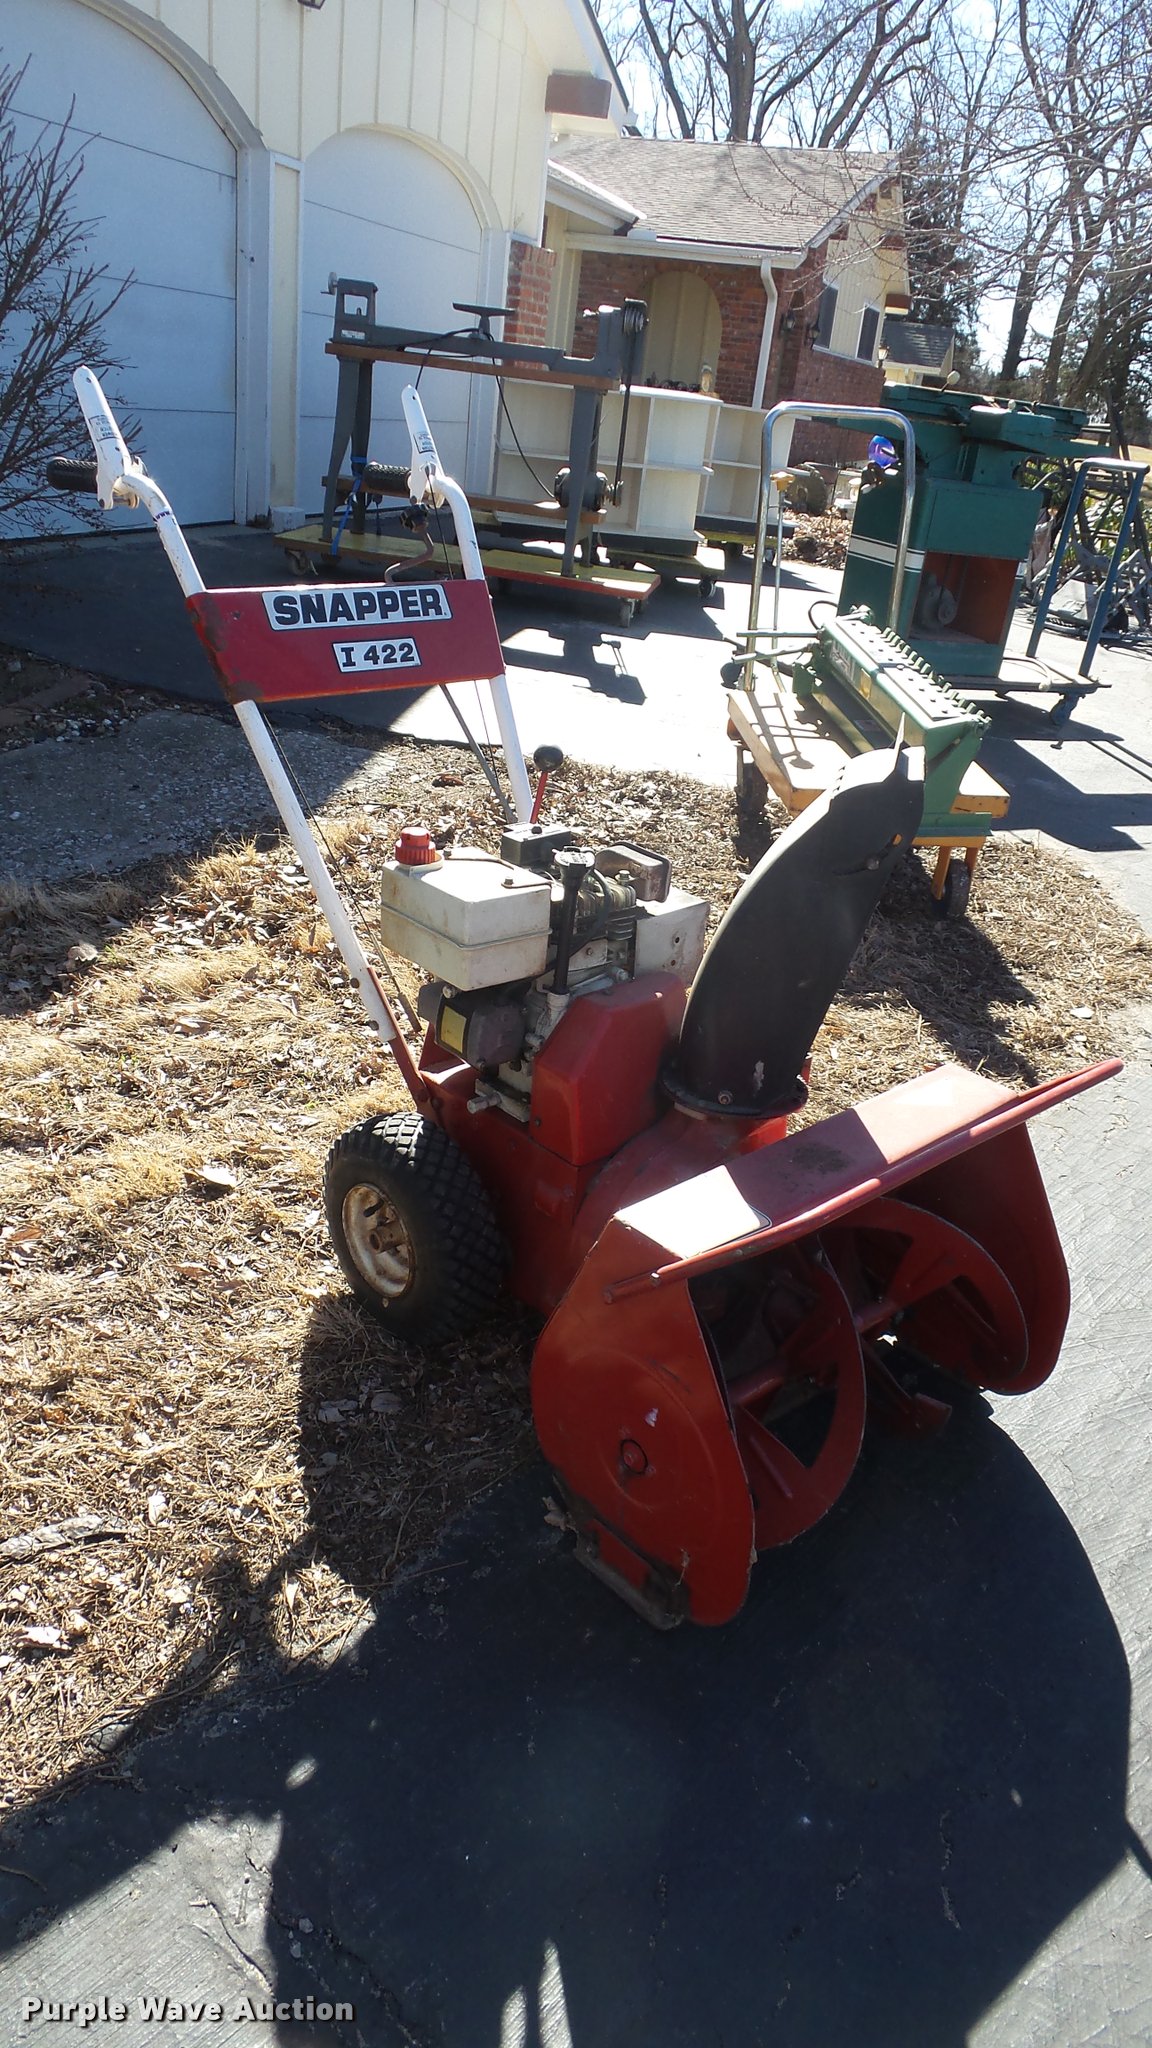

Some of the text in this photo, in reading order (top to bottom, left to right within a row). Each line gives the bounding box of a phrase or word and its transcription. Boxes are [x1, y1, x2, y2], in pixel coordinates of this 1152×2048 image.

[273, 588, 443, 626] SNAPPER
[340, 642, 415, 667] I 422
